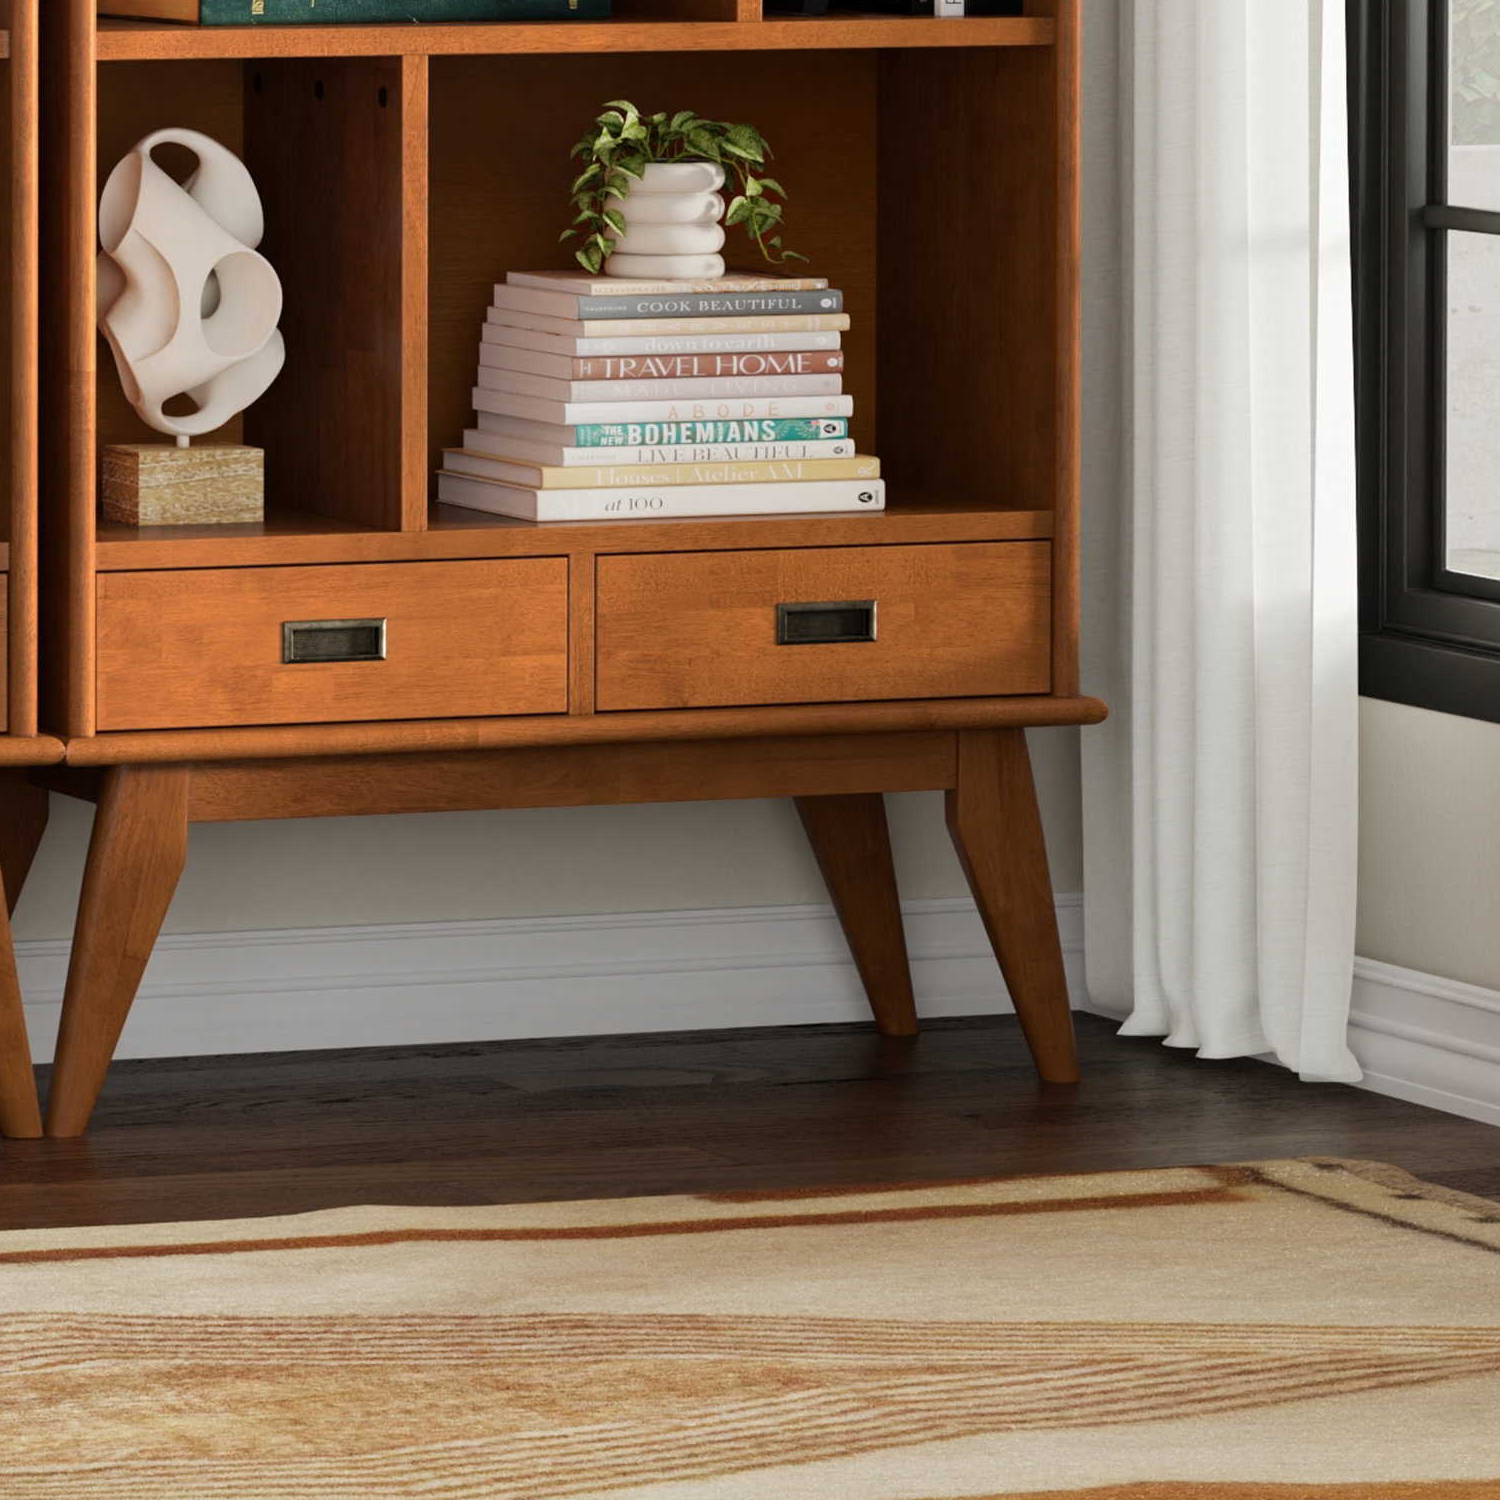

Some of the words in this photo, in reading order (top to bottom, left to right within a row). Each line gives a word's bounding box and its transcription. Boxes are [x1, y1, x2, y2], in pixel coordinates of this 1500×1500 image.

[637, 300, 691, 313] COOK
[698, 298, 803, 312] BEAUTIFUL
[644, 337, 699, 352] down
[701, 336, 722, 350] to
[725, 333, 776, 350] earth
[599, 356, 706, 379] TRAVEL
[715, 353, 813, 376] HOME
[612, 382, 685, 397] MADE
[710, 379, 797, 396] LIVING
[668, 402, 780, 420] ABODE
[603, 425, 624, 436] THE
[627, 420, 777, 446] BOHEMIANS
[599, 436, 624, 446] NEW
[638, 448, 686, 462] LIVE
[692, 445, 814, 461] BEAUTIFUL
[597, 467, 670, 485] Houses
[687, 464, 758, 483] Atelier
[761, 462, 805, 481] AM
[605, 498, 623, 511] at
[629, 496, 664, 511] 100
